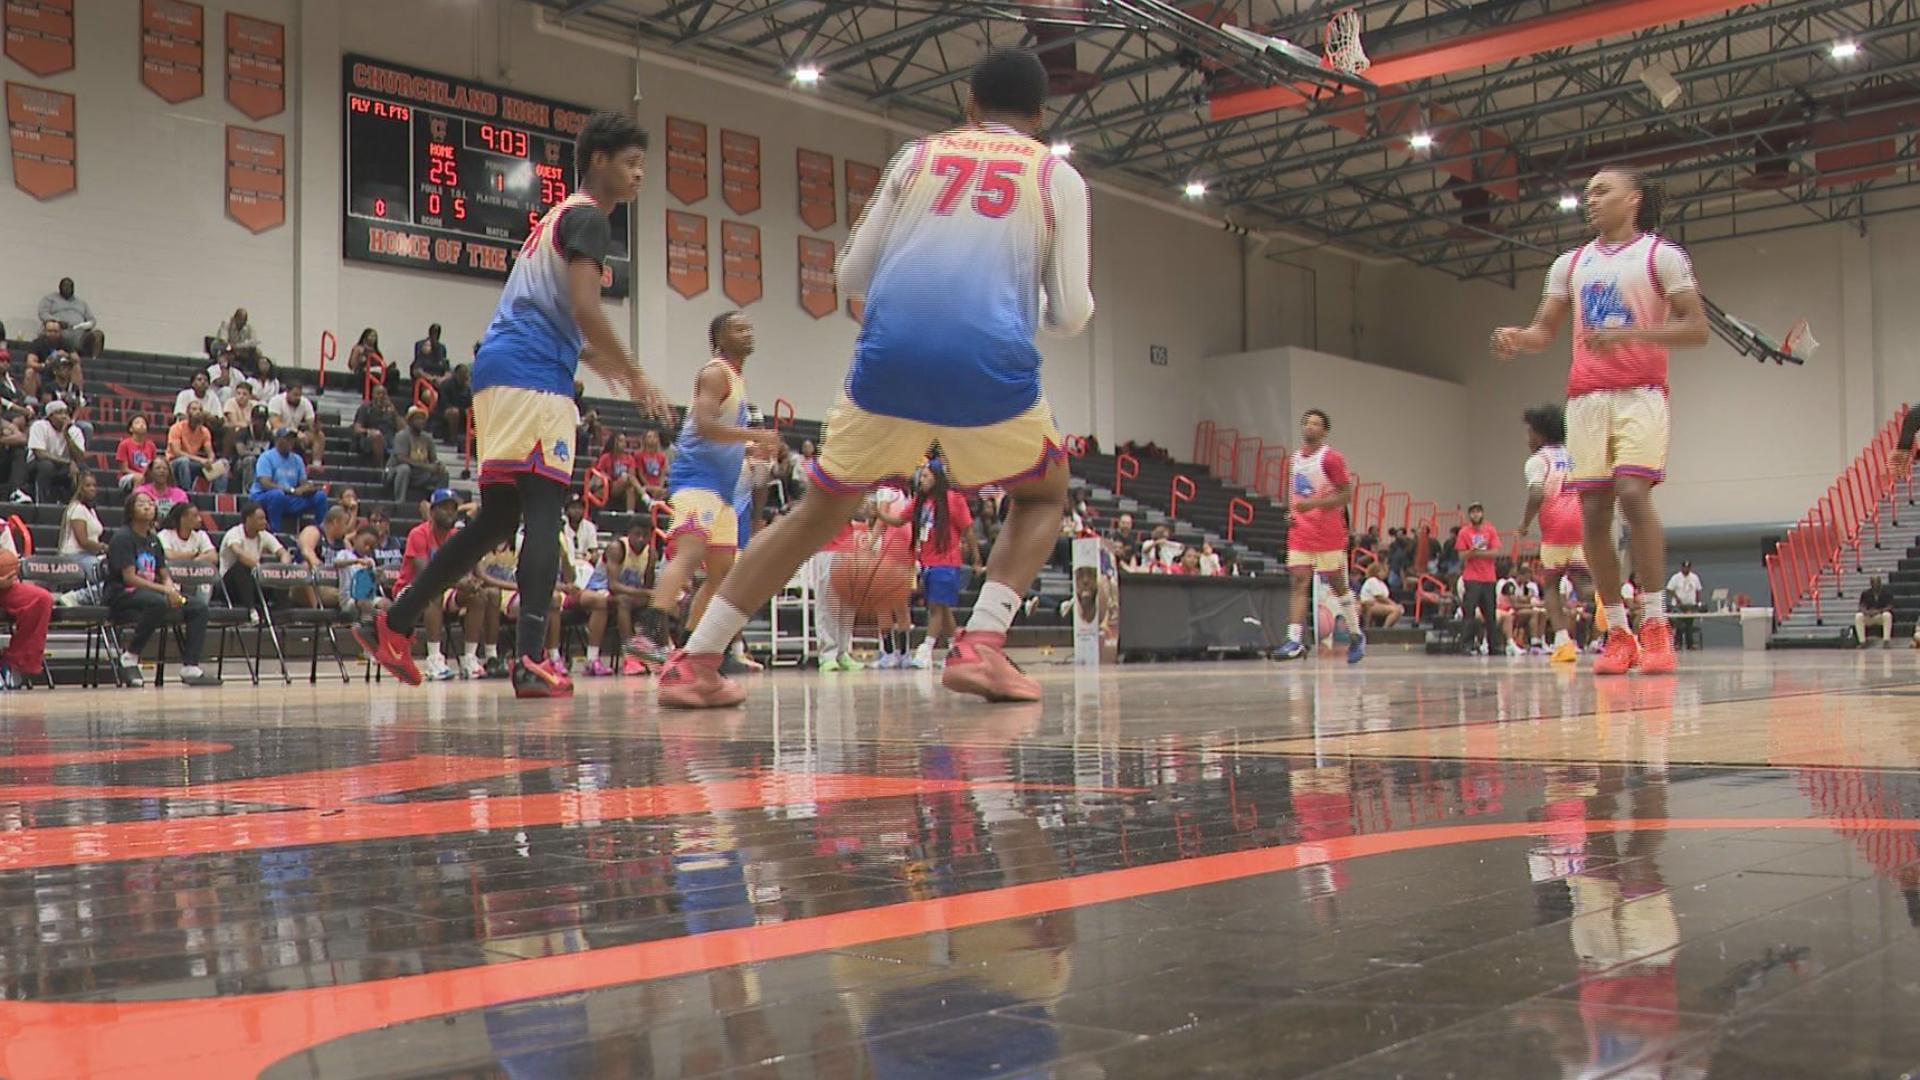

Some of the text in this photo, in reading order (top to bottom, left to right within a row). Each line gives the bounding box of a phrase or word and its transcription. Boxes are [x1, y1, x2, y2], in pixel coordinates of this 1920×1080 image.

[351, 98, 409, 121] PLY FL PTS
[353, 63, 592, 134] CHURCHLAND HIGH SCH
[429, 143, 454, 159] HOME
[481, 125, 527, 158] 9:03
[429, 158, 457, 186] 25
[541, 178, 567, 206] 33
[931, 154, 1023, 219] 75
[428, 193, 442, 216] 0
[369, 227, 431, 260] HOME
[435, 238, 461, 264] OF
[467, 243, 507, 272] THE
[28, 562, 79, 574] THE LAND
[169, 566, 215, 576] THE LAND
[262, 569, 308, 578] THE LAND
